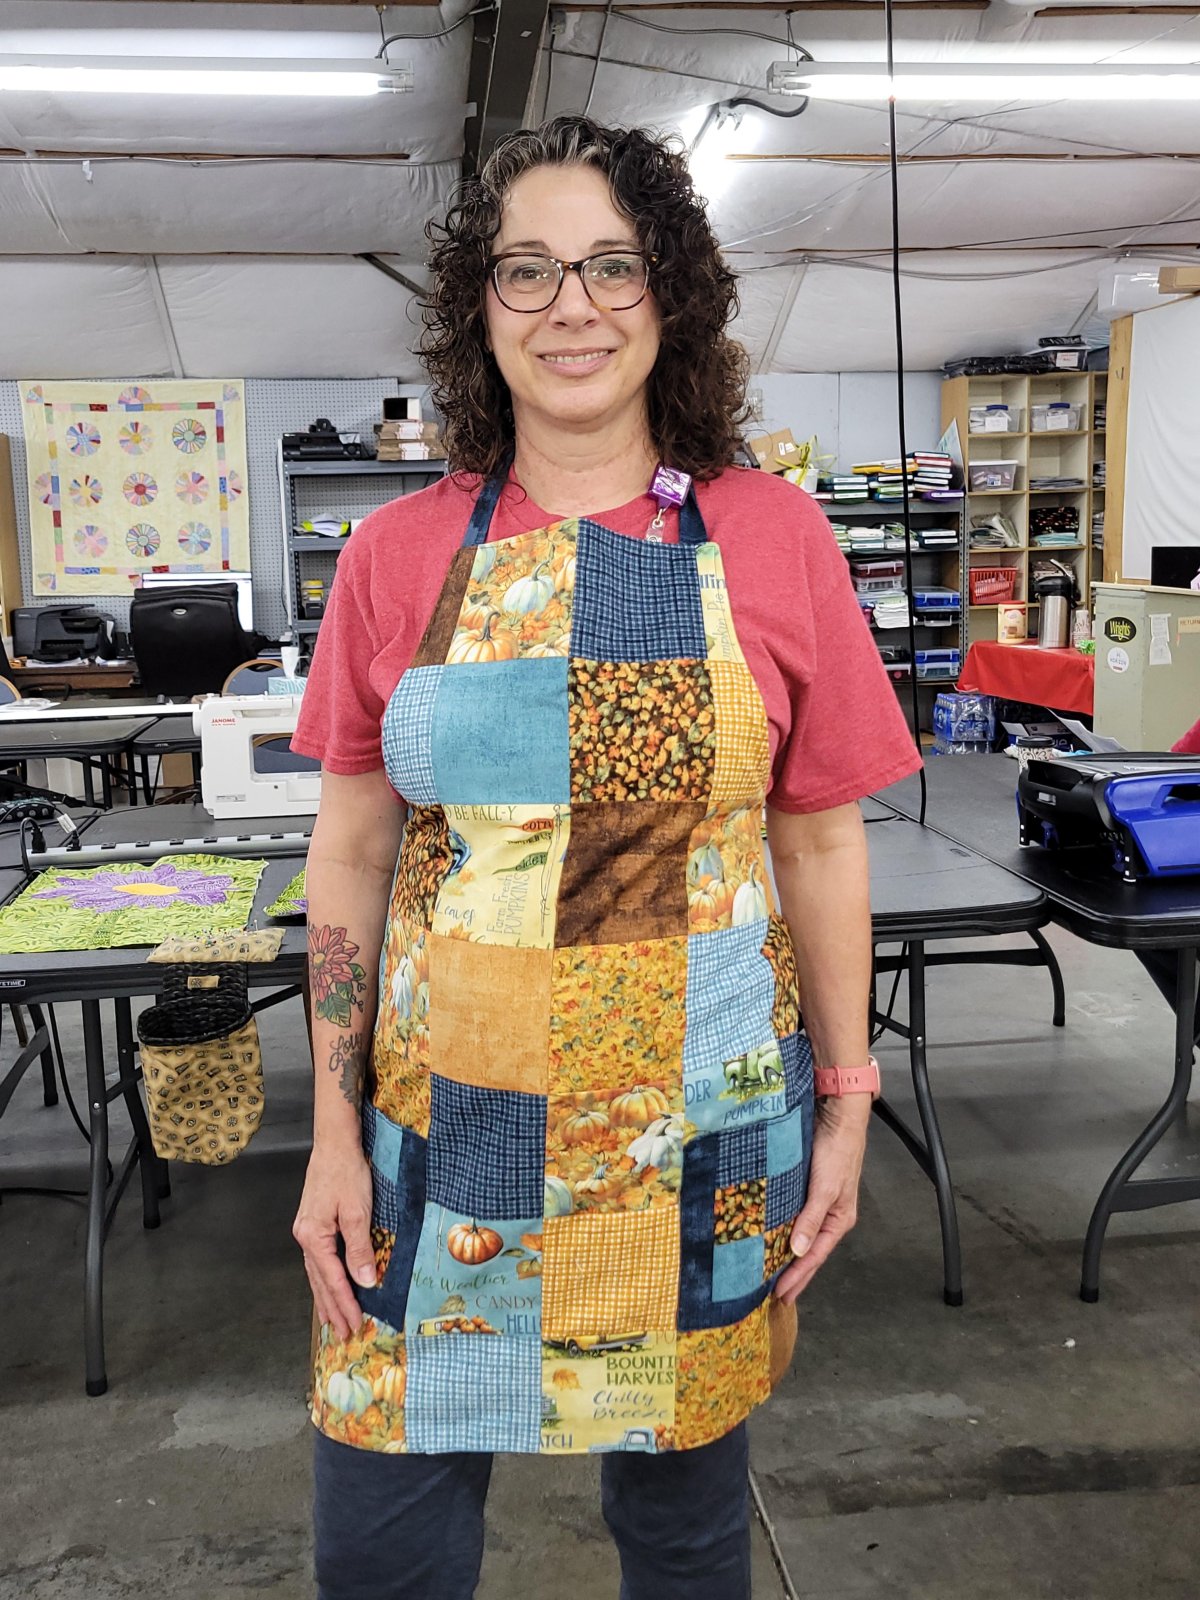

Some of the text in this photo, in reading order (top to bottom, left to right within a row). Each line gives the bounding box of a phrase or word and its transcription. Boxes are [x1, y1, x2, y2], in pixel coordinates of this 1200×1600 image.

[454, 805, 470, 820] BE
[471, 805, 518, 821] FALL-Y
[504, 872, 530, 936] PUMPKINS
[684, 1078, 711, 1106] DER
[723, 1093, 785, 1125] PUMPKIN
[475, 1294, 536, 1309] CANDY
[507, 1313, 541, 1335] HELL
[606, 1370, 674, 1386] HARVES
